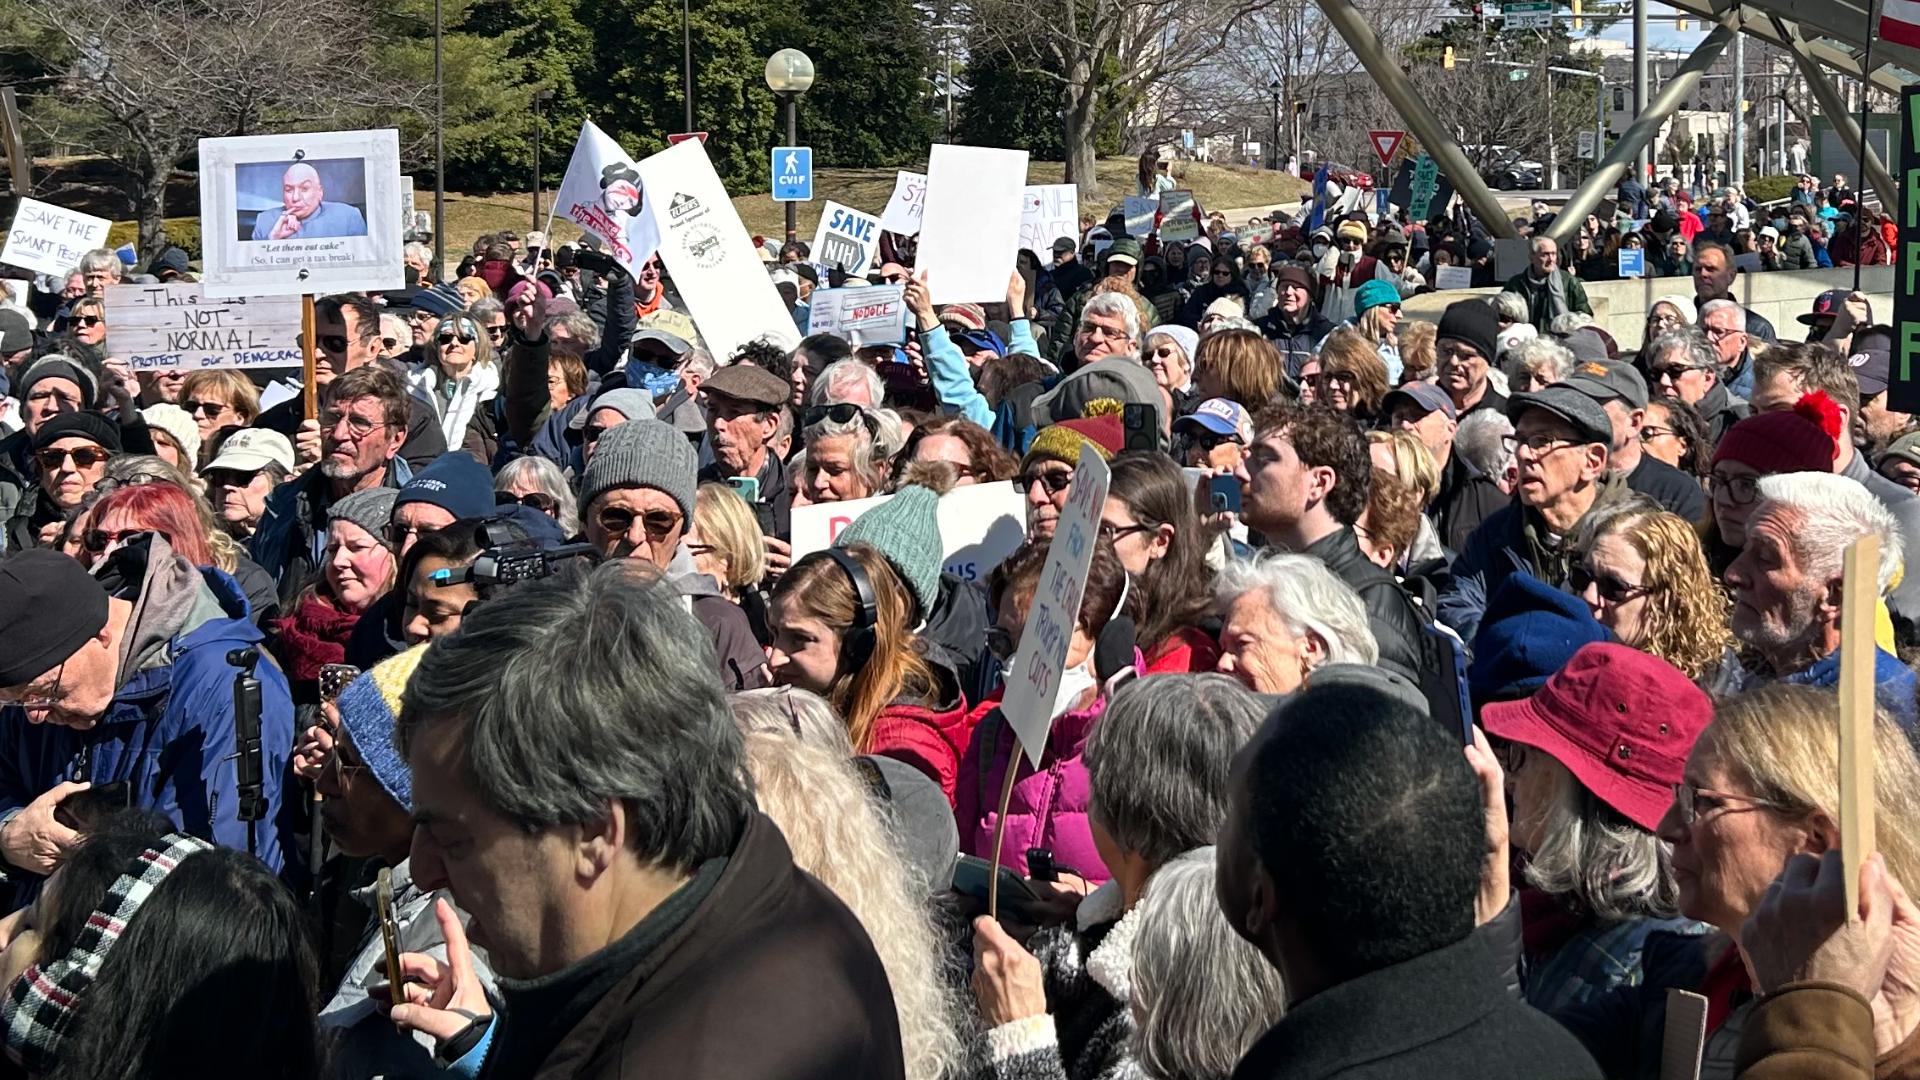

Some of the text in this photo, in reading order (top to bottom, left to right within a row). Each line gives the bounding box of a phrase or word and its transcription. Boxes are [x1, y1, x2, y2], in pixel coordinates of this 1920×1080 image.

[778, 175, 806, 185] CVIF
[902, 184, 927, 203] ST
[22, 206, 98, 241] SAVE THE
[829, 209, 876, 243] SAVE
[13, 230, 82, 262] SMART PEOP
[282, 243, 303, 252] them
[305, 242, 319, 251] eat
[825, 239, 856, 270] NIH
[293, 256, 305, 265] get
[144, 288, 199, 307] This
[184, 309, 230, 329] NOT
[167, 329, 268, 352] NORMAL
[131, 354, 184, 369] PROTECT
[233, 351, 303, 363] DEMOCRAC
[1049, 560, 1067, 602] THE
[1028, 650, 1052, 698] CUTS
